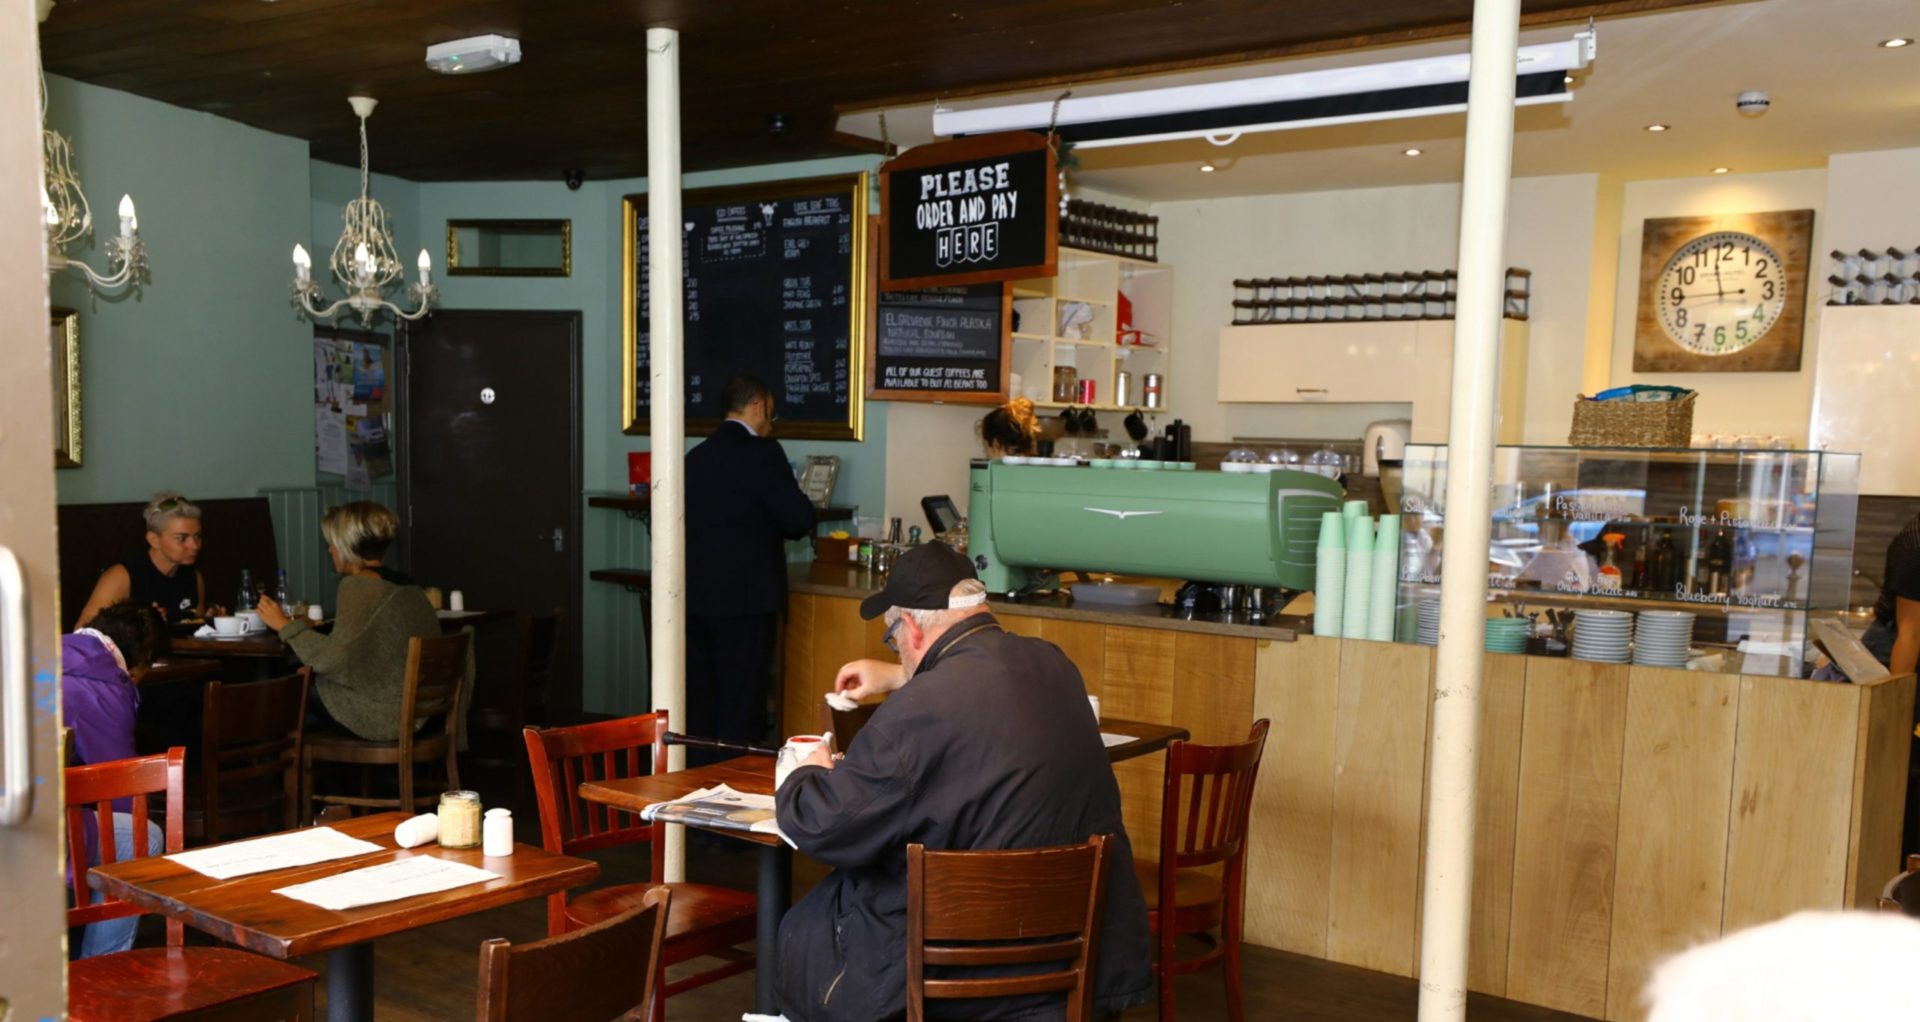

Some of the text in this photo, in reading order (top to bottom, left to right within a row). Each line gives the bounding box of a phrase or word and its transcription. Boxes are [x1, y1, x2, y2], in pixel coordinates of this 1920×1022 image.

[920, 162, 1010, 200] PLEASE
[917, 191, 1018, 230] ORDER AND PAY
[939, 229, 995, 259] HERE
[1713, 241, 1735, 261] 12
[1692, 248, 1708, 268] 11
[1742, 246, 1750, 266] 1
[1675, 266, 1695, 286] 10
[1755, 259, 1768, 279] 2
[1671, 287, 1682, 307] 9
[1762, 281, 1775, 301] 3
[1675, 308, 1688, 328] 8
[1752, 303, 1765, 323] 4
[1694, 323, 1706, 343] 7
[1714, 326, 1726, 346] 6
[1735, 320, 1748, 340] 5
[885, 366, 985, 379] ALL OF OUR GUEST COFFEES ARE
[884, 378, 988, 389] AVAILABLE TO BUY AS BEANS TOO
[1680, 505, 1708, 527] Rose
[1676, 581, 1730, 612] Blueberry
[1734, 590, 1780, 612] Yoghurt
